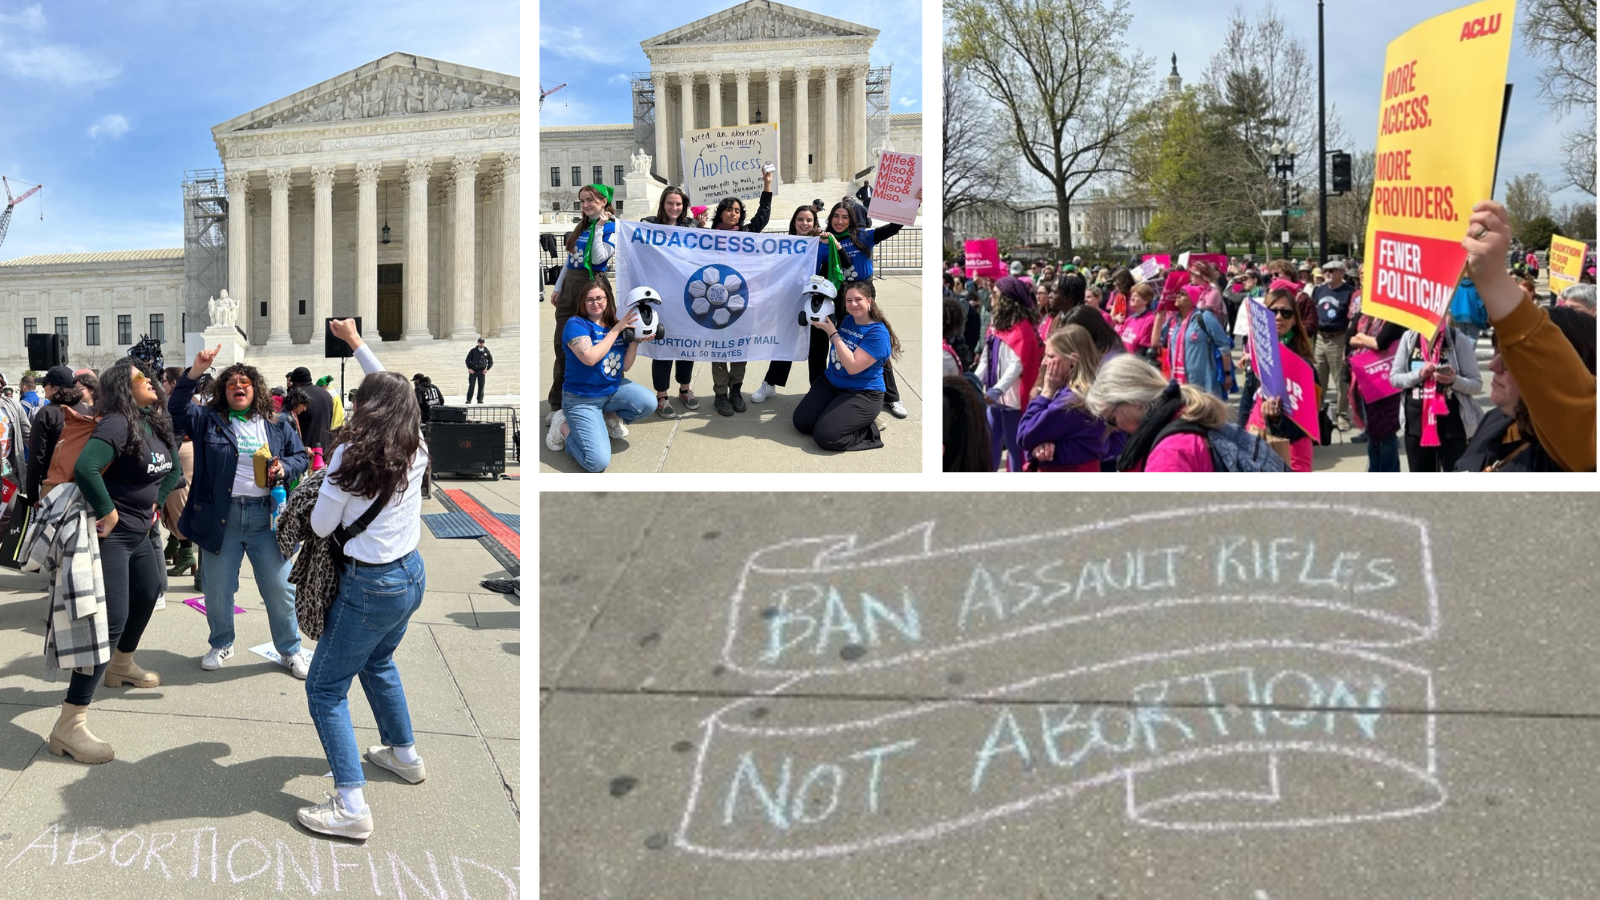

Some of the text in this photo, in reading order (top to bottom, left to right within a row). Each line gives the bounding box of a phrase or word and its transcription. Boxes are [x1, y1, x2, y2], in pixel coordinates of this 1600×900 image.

[1460, 12, 1502, 42] ACLU
[1384, 59, 1418, 101] MORE
[1380, 94, 1432, 137] ACCESS.
[364, 136, 401, 147] JUSTICE
[405, 134, 437, 144] UNDER
[691, 132, 711, 144] Need
[731, 127, 766, 138] abortion?
[706, 142, 718, 150] WE
[721, 139, 735, 147] CAN
[879, 162, 916, 177] Miso&
[881, 152, 916, 168] Mife&
[1375, 149, 1412, 182] MORE
[875, 180, 911, 195] Miso&
[877, 171, 914, 186] Miso&
[872, 188, 902, 203] Miso.
[1374, 185, 1459, 223] PROVIDERS.
[630, 227, 809, 255] AIDACCESS.ORG
[1379, 238, 1422, 275] FEWER
[650, 335, 780, 349] BORTION PILLS BY MAIL
[680, 350, 697, 358] ALL
[710, 349, 742, 358] STATES
[764, 584, 922, 664] BAN
[958, 546, 1187, 631] ASSAULT
[723, 667, 1385, 830] NOT ABORTION
[4, 822, 520, 900] ABORTIONFIND
